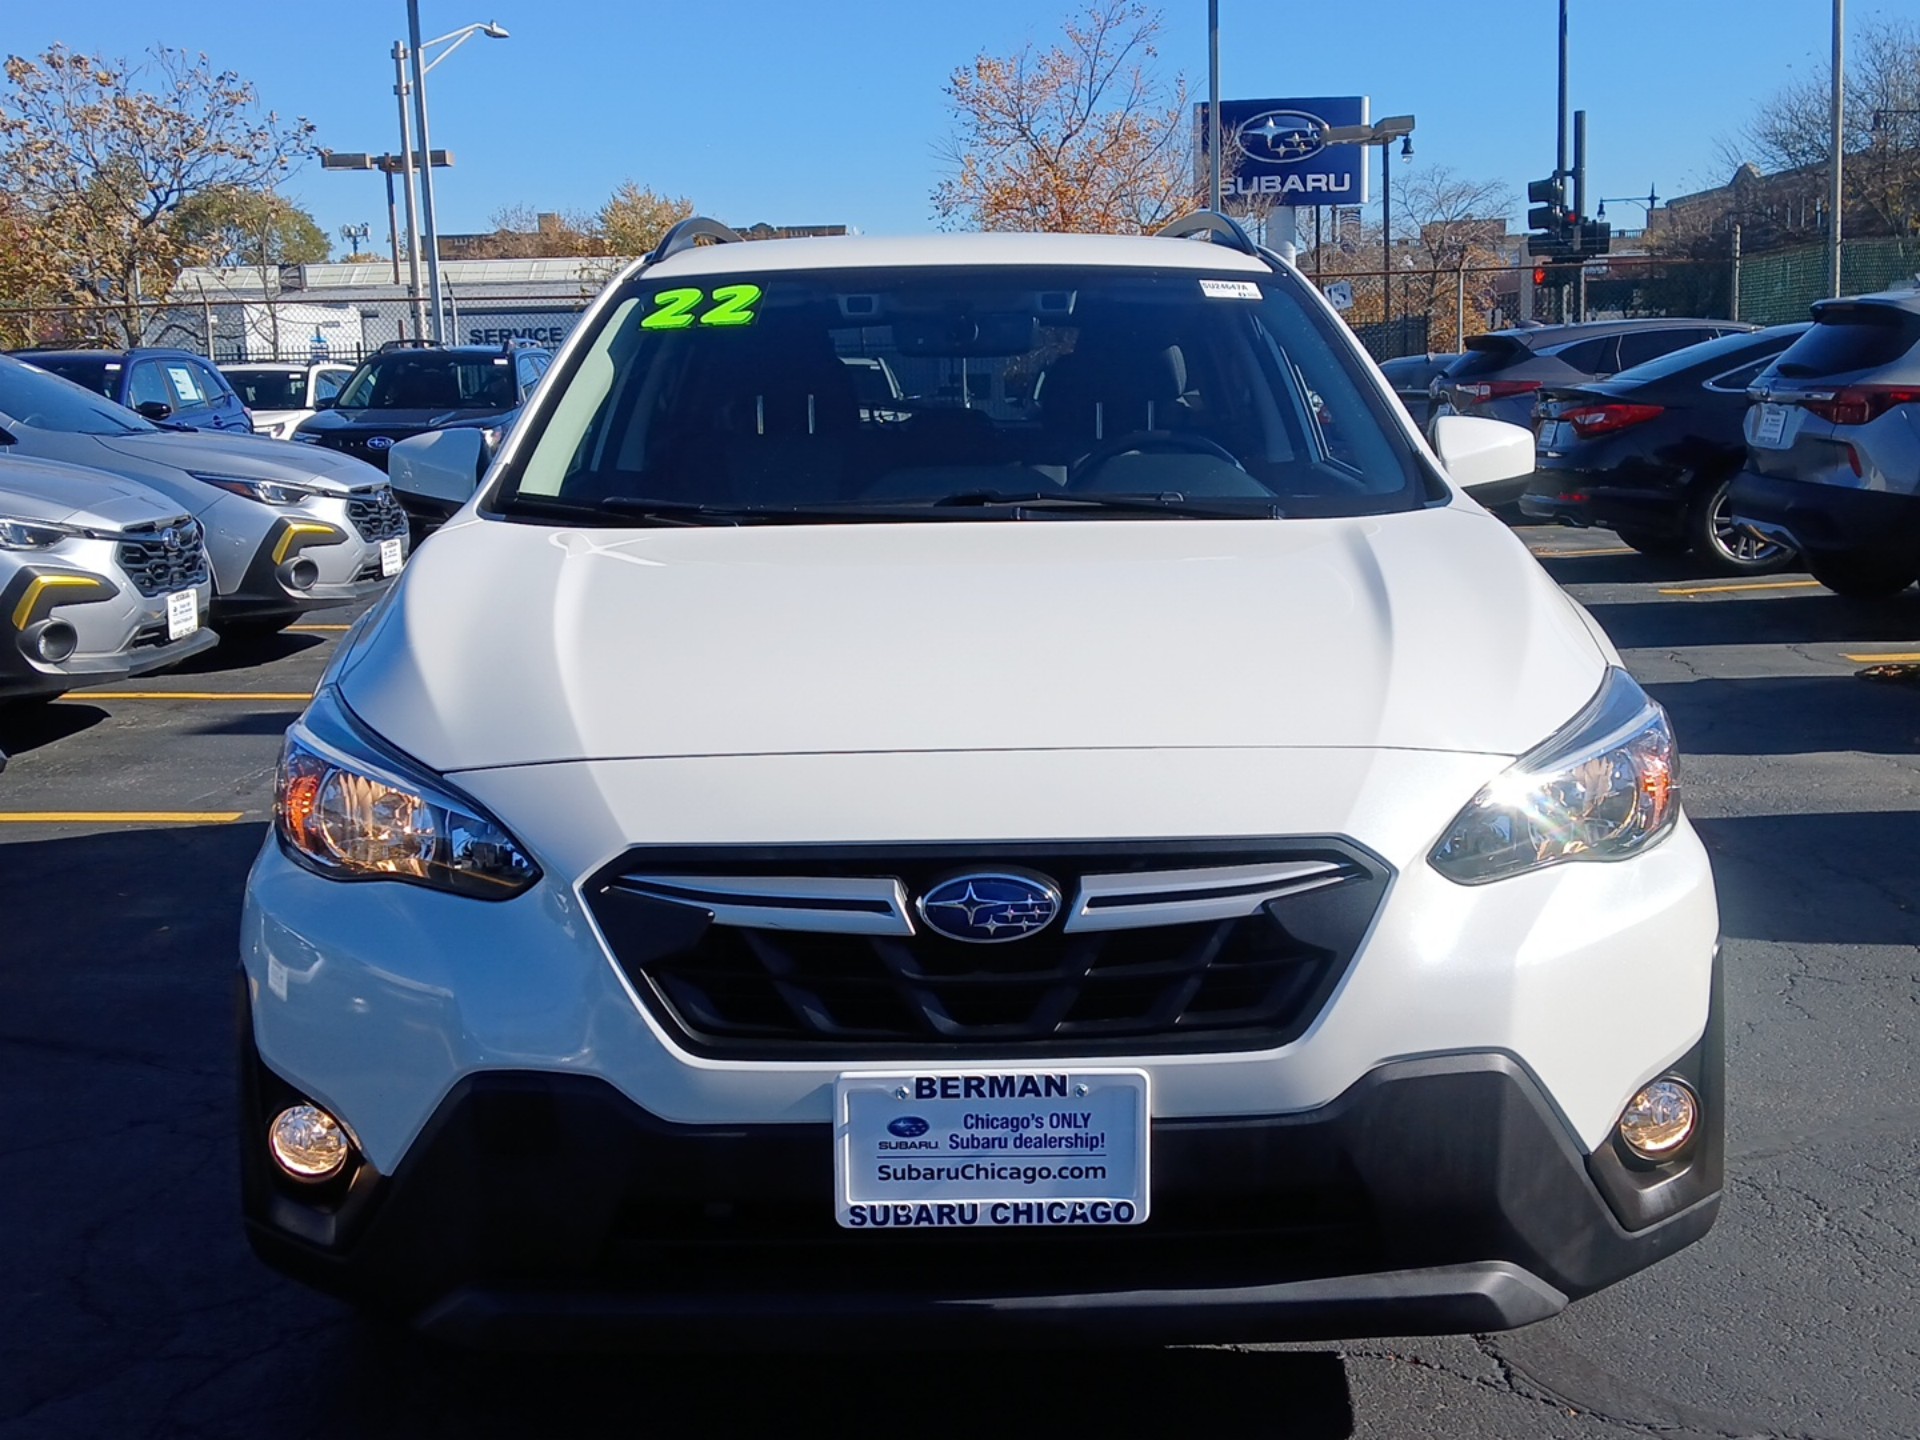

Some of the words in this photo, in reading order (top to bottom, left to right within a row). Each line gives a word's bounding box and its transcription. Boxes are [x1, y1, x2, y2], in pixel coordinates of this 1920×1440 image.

[1219, 172, 1350, 196] SUBARU
[640, 284, 761, 329] 22
[469, 326, 564, 345] SERVICE
[914, 1074, 1069, 1100] BERMAN
[963, 1112, 1044, 1132] Chicago's
[1049, 1112, 1092, 1130] ONLY
[877, 1140, 940, 1150] SUBARU
[949, 1133, 1008, 1150] Subaru
[1013, 1132, 1106, 1152] dealership!
[876, 1162, 1107, 1184] SubaruChicago.com
[849, 1202, 979, 1227] SUBARU
[990, 1200, 1136, 1224] CHICAGO
